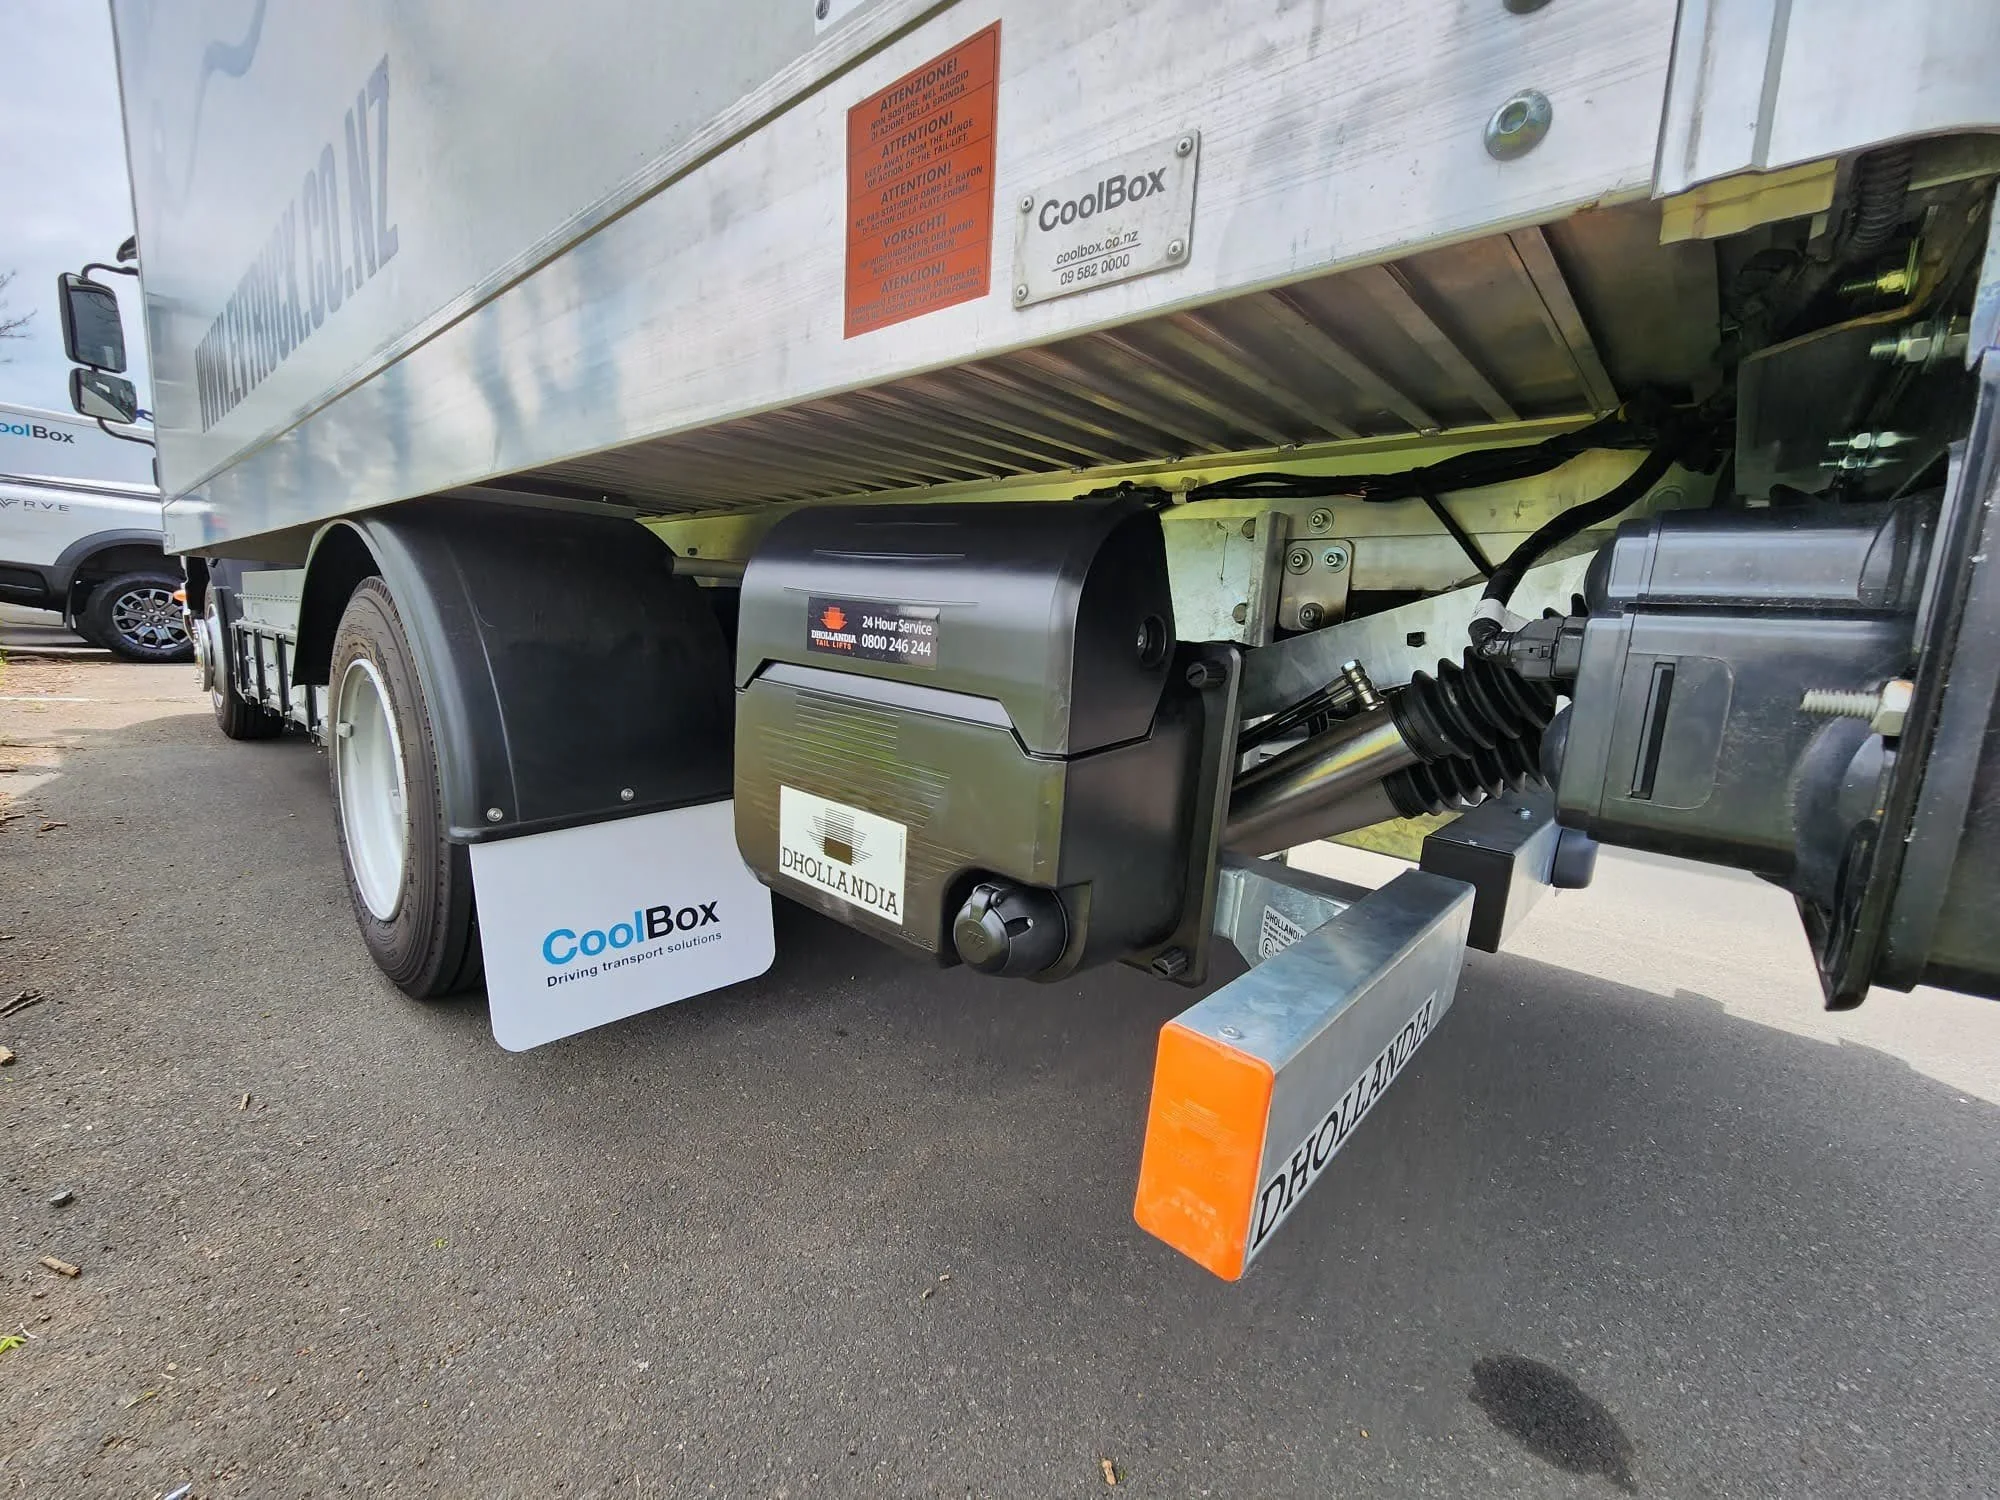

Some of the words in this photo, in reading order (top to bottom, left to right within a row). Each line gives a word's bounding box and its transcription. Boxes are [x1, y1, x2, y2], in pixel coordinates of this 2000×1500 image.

[870, 115, 887, 131] NON
[888, 100, 919, 122] SOSTARE
[922, 89, 937, 101] NEL
[940, 70, 969, 92] RAGGIO
[880, 57, 958, 113] ATTENZIONE!
[880, 117, 905, 136] AZIONE
[907, 103, 931, 121] DELLA
[881, 110, 954, 159] ATTENTION!
[864, 163, 882, 179] KEEP
[883, 153, 903, 171] AWAY
[906, 141, 927, 157] FROM
[929, 132, 944, 146] THE
[946, 118, 974, 139] RANGE
[867, 175, 878, 188] OF
[879, 165, 904, 185] ACTION
[905, 157, 914, 169] OF
[917, 151, 931, 162] THE
[880, 160, 952, 206] ATTENTION!
[955, 164, 983, 184] RAYON
[1038, 166, 1166, 232] CoolBox
[883, 213, 947, 249] VORSICHT!
[1056, 230, 1139, 265] coolbox.co.nz
[881, 262, 946, 294] ATENCION!
[1060, 271, 1075, 286] 09
[1076, 263, 1098, 281] 582
[1101, 254, 1131, 274] 0000
[0, 422, 75, 444] oolBox
[811, 630, 857, 644] DHOLLANDIA
[862, 615, 873, 628] 24
[874, 616, 898, 632] Hour
[898, 619, 932, 636] Service
[815, 639, 830, 647] TAIL
[832, 642, 852, 650] LIFTS
[861, 633, 887, 650] 0800
[888, 637, 909, 653] 246
[911, 640, 931, 657] 244
[782, 846, 898, 915] DHOLLANDIA
[542, 900, 720, 965] CoolBox
[547, 966, 598, 987] Driving
[602, 946, 663, 972] transport
[667, 931, 722, 953] solutions
[1252, 998, 1432, 1250] DHOLLANDIA
